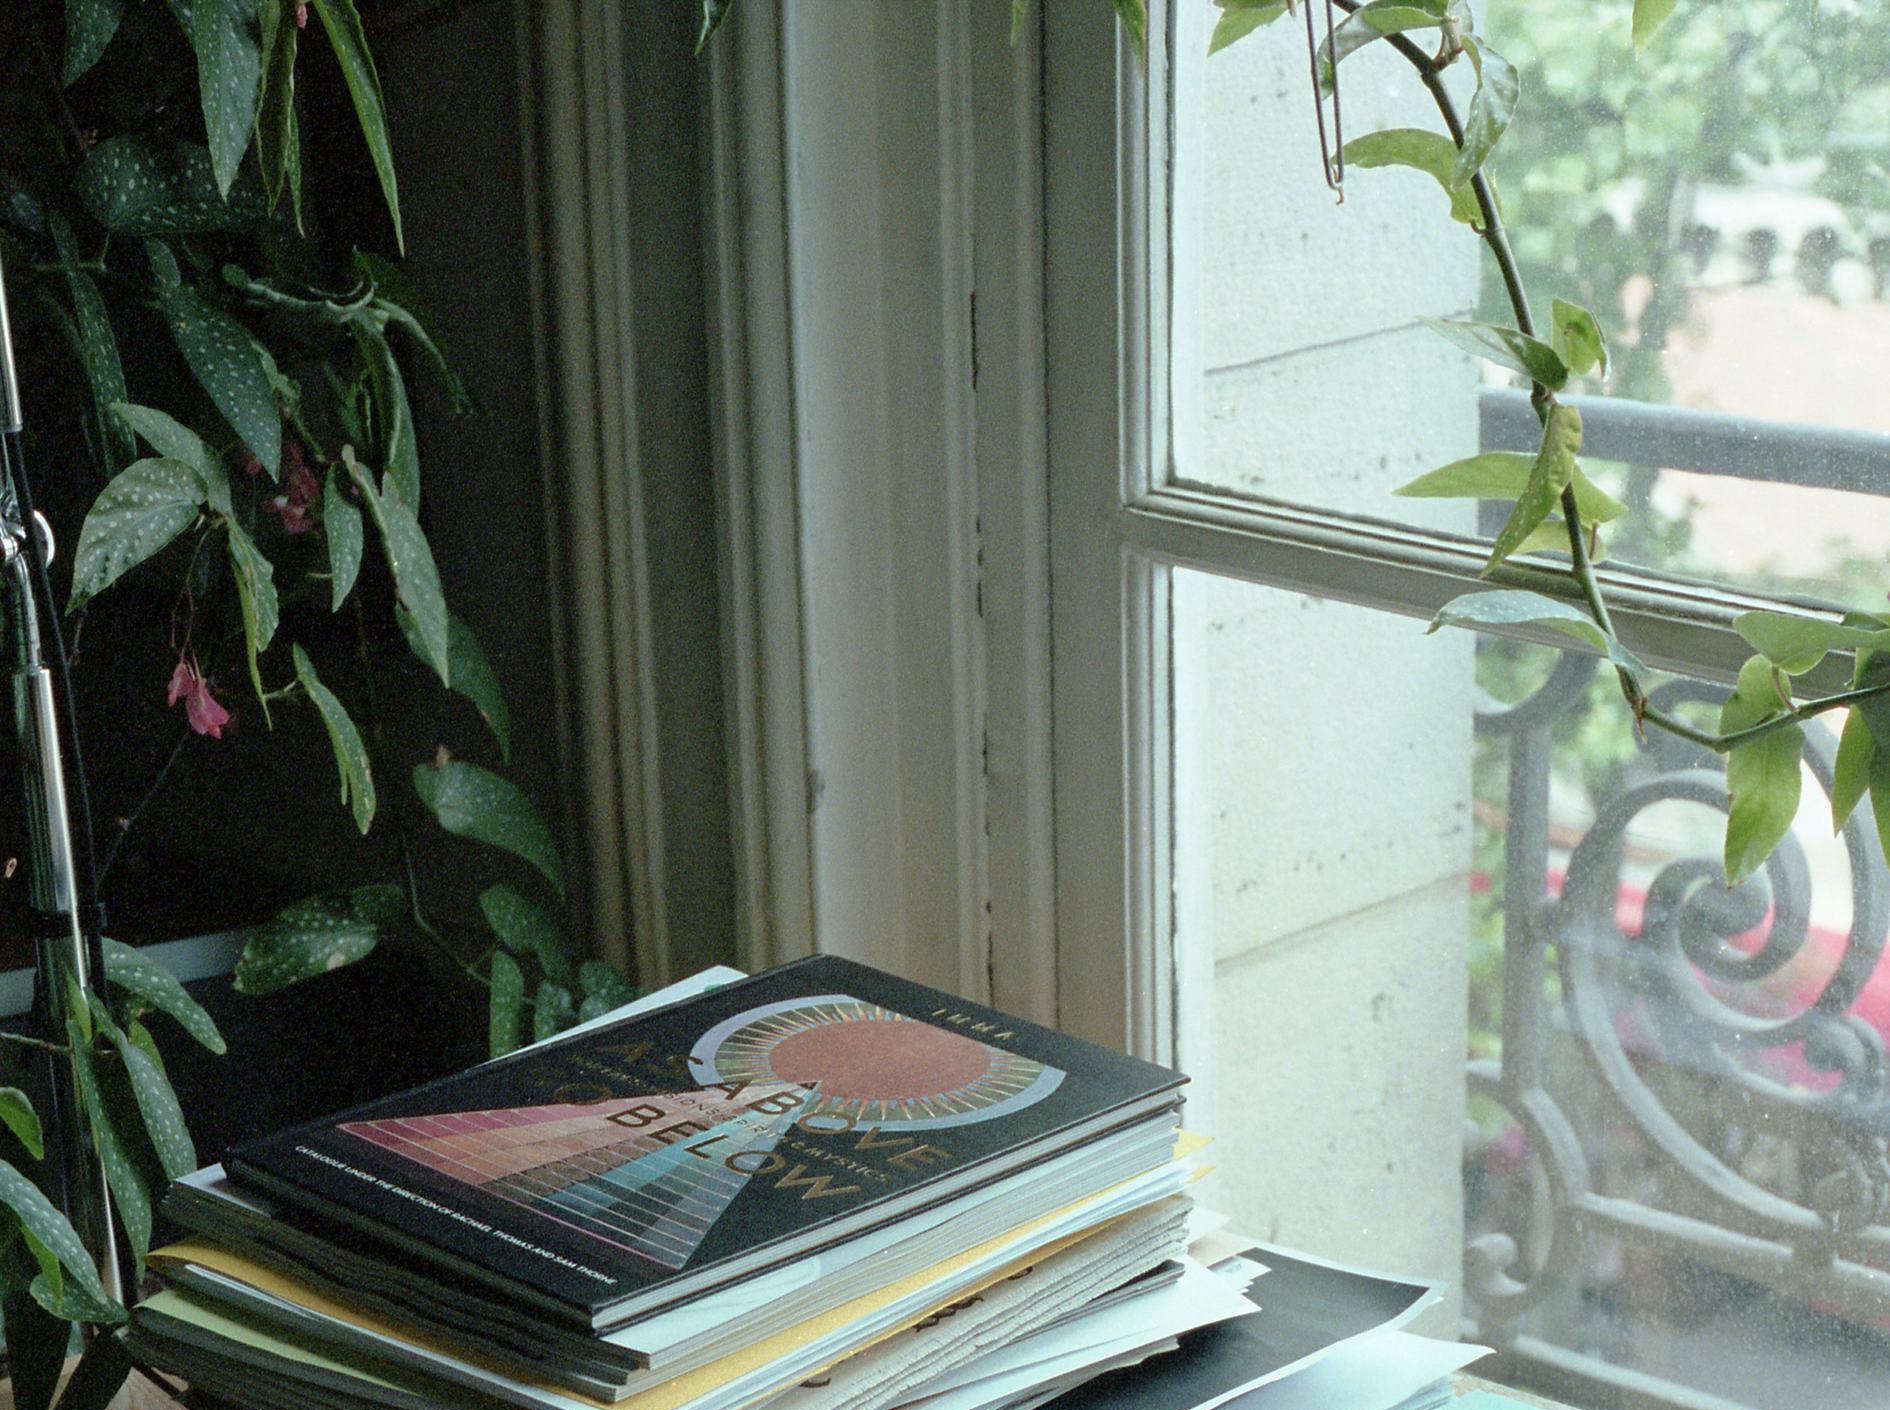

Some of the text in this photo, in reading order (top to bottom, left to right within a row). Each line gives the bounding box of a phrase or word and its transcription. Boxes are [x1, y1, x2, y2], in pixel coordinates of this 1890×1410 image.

[931, 1008, 1016, 1041] IMMA
[597, 1042, 704, 1077] AS
[690, 1079, 953, 1173] ABOVE
[604, 1103, 861, 1200] BELOW
[806, 1145, 893, 1185] MYSTICS
[295, 1145, 618, 1285] CATALOGUE UNDER THE DIRECTION OF RACHAEL THOMAS AND SAM THORNE
